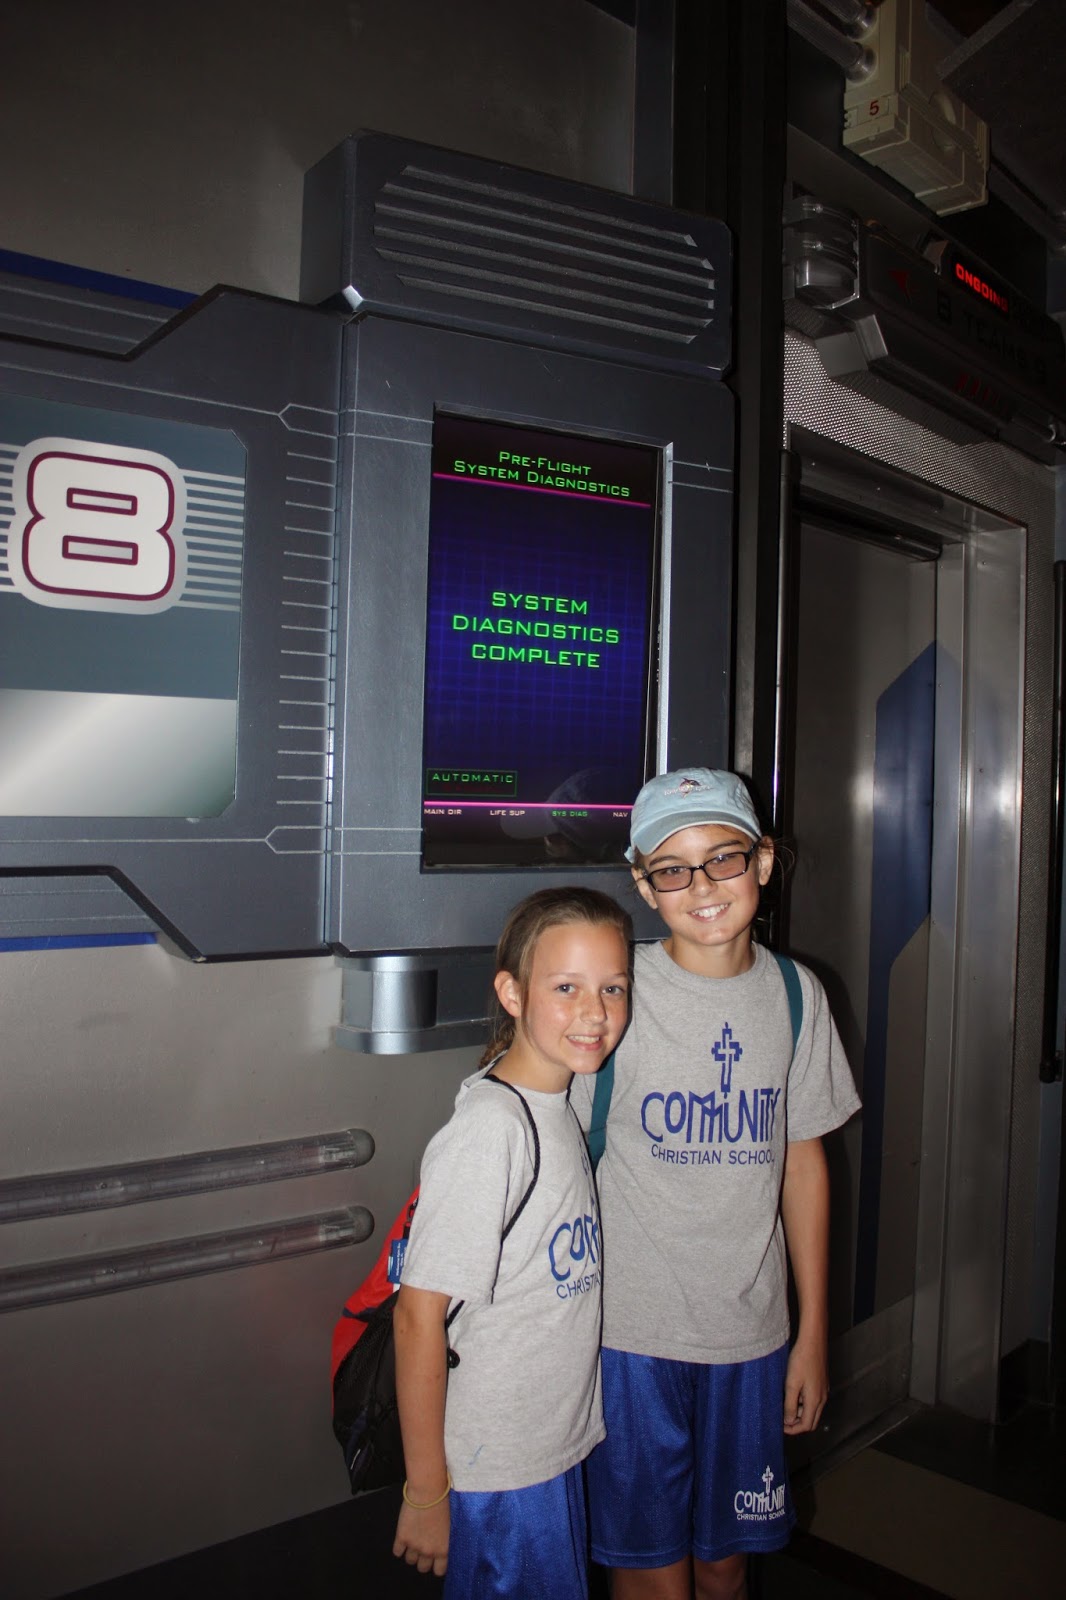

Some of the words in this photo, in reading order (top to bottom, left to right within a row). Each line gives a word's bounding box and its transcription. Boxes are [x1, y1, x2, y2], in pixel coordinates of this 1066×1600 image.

[869, 100, 879, 116] 5
[955, 262, 1009, 314] ONGOING
[499, 451, 592, 476] PRE-FLIGHT
[453, 460, 520, 481] SYSTEM
[526, 471, 631, 497] DIAGNOSTICS
[20, 449, 177, 603] 8
[491, 591, 588, 615] SYSTEM
[452, 614, 620, 644] DIAGNOSTICS
[471, 643, 601, 668] COMPLETE
[431, 772, 514, 784] AUTOMATIC
[448, 808, 463, 816] DIR
[551, 810, 568, 818] SYS
[640, 1087, 781, 1144] COMMUNITY
[651, 1143, 722, 1166] CHRISTIAN
[556, 1268, 601, 1299] CHRISTIA
[737, 1513, 767, 1521] CHRISTIAN
